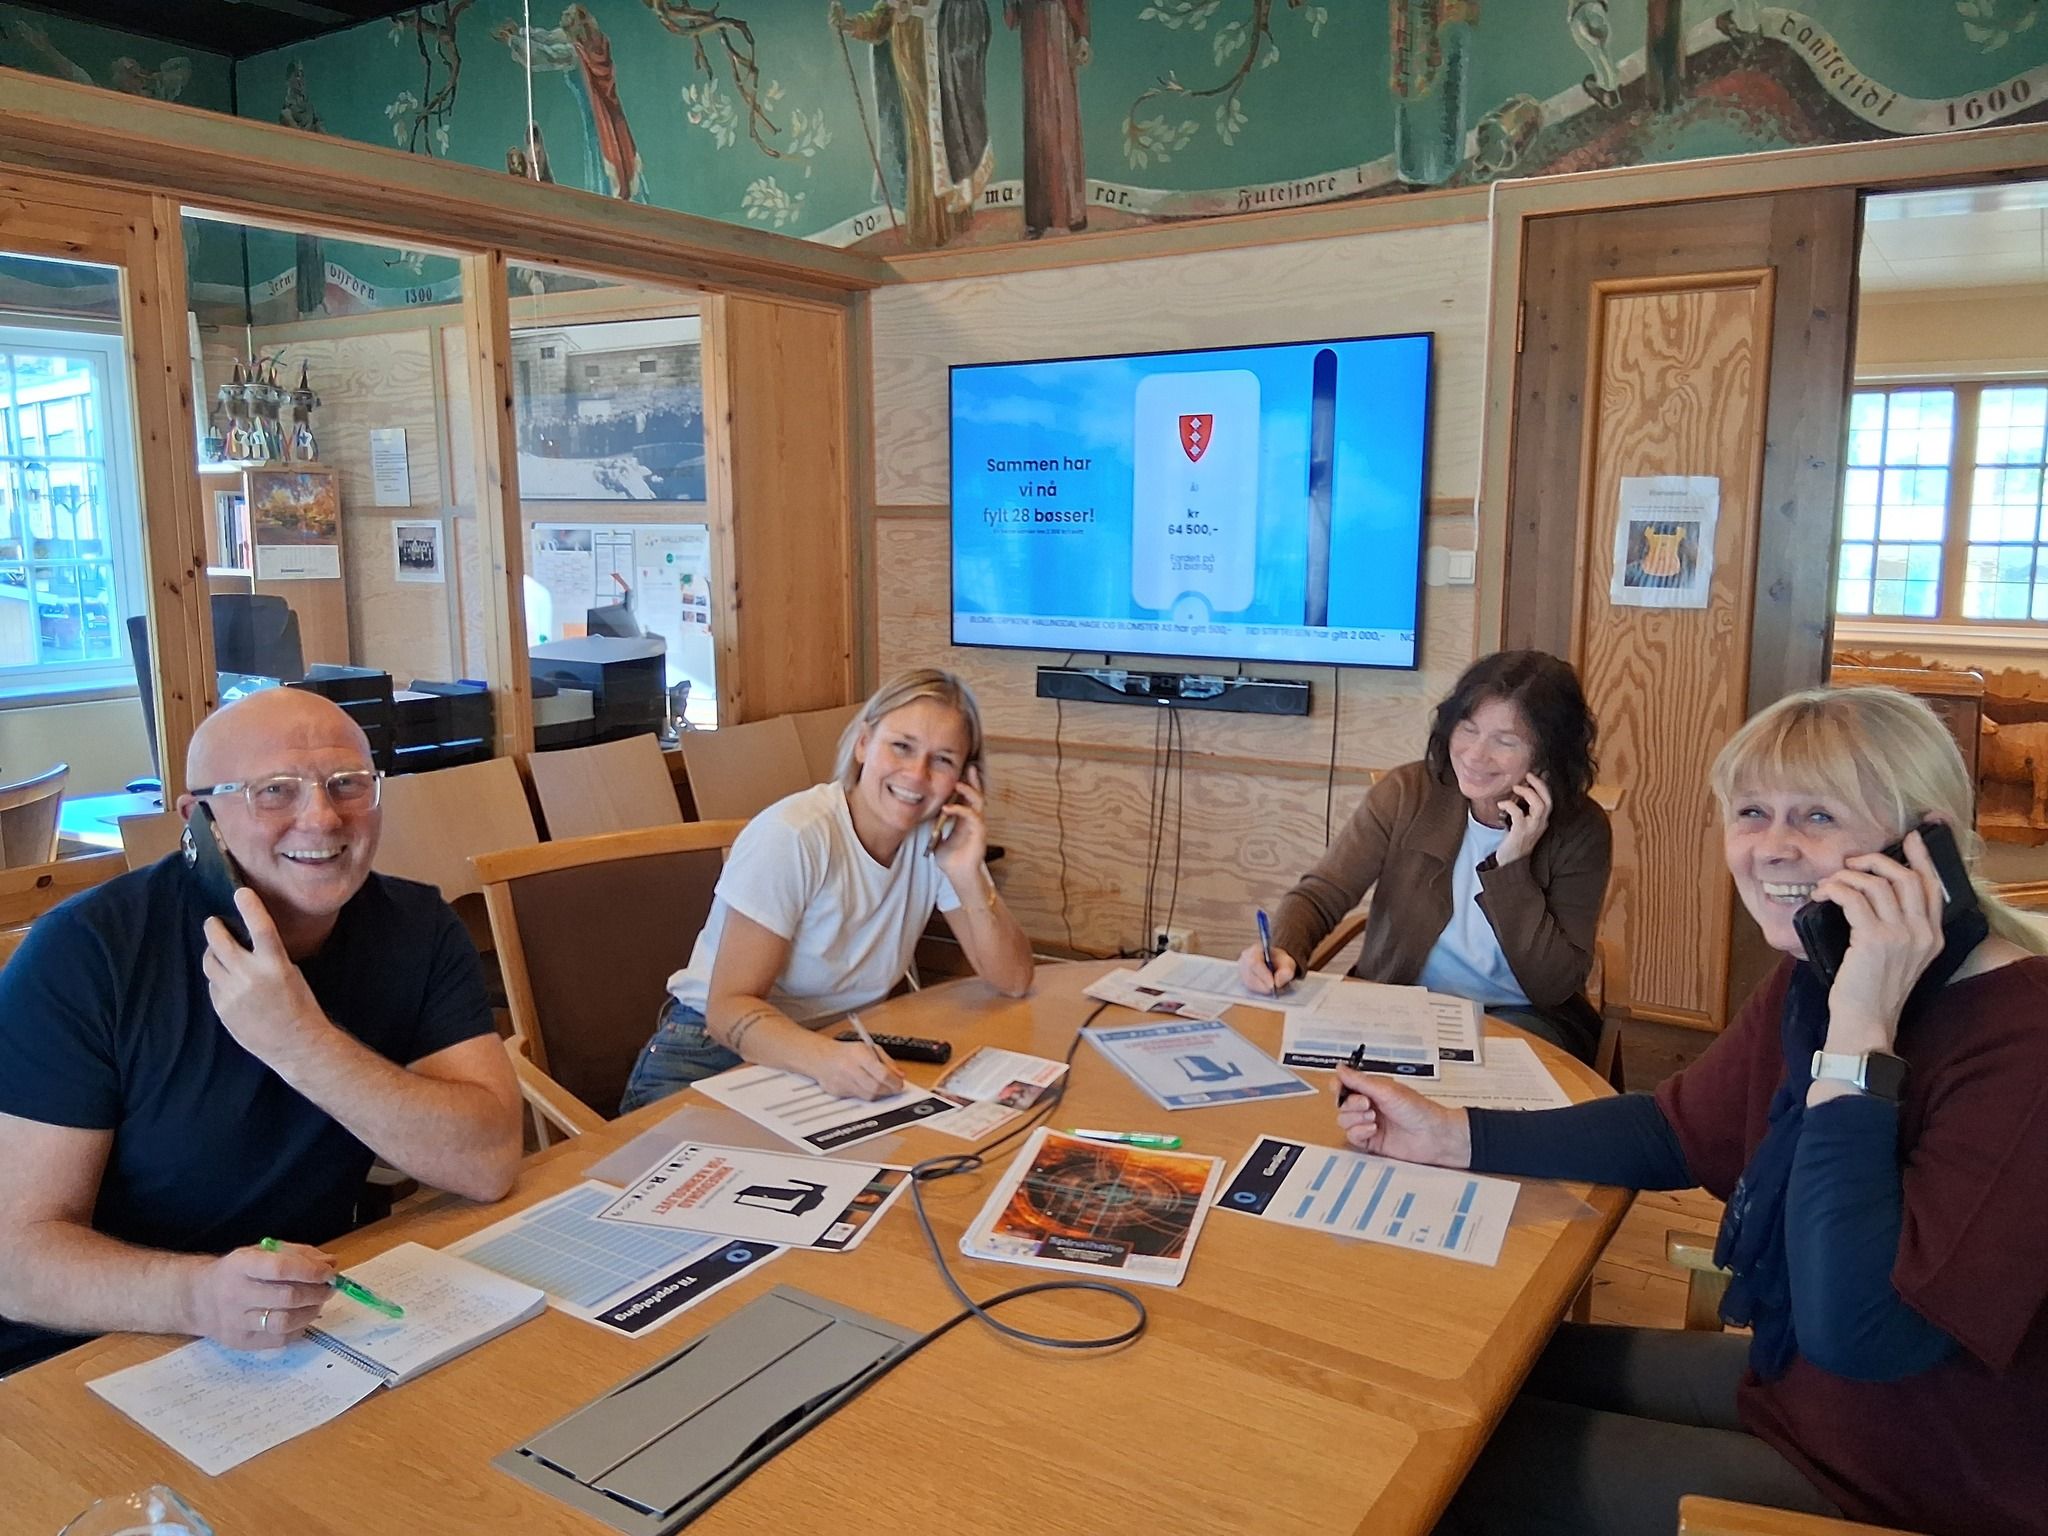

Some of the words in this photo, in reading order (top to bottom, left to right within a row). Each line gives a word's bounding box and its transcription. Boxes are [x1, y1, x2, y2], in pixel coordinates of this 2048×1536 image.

[1946, 79, 2031, 126] 1600
[405, 287, 433, 304] 1300
[987, 458, 1059, 472] Sammen
[1063, 456, 1092, 471] har
[1018, 481, 1033, 497] vi
[1037, 480, 1057, 497] nå
[983, 507, 1009, 527] fylt
[1012, 508, 1030, 523] 28
[1034, 507, 1094, 523] bøsser!
[1187, 508, 1200, 518] kr
[1168, 524, 1183, 535] 64
[1186, 524, 1219, 536] 500,-
[1117, 621, 1160, 632] BLOMSTER
[1313, 629, 1329, 639] har
[1331, 630, 1348, 641] gitt
[1350, 631, 1357, 640] 2
[676, 1276, 698, 1287] Til
